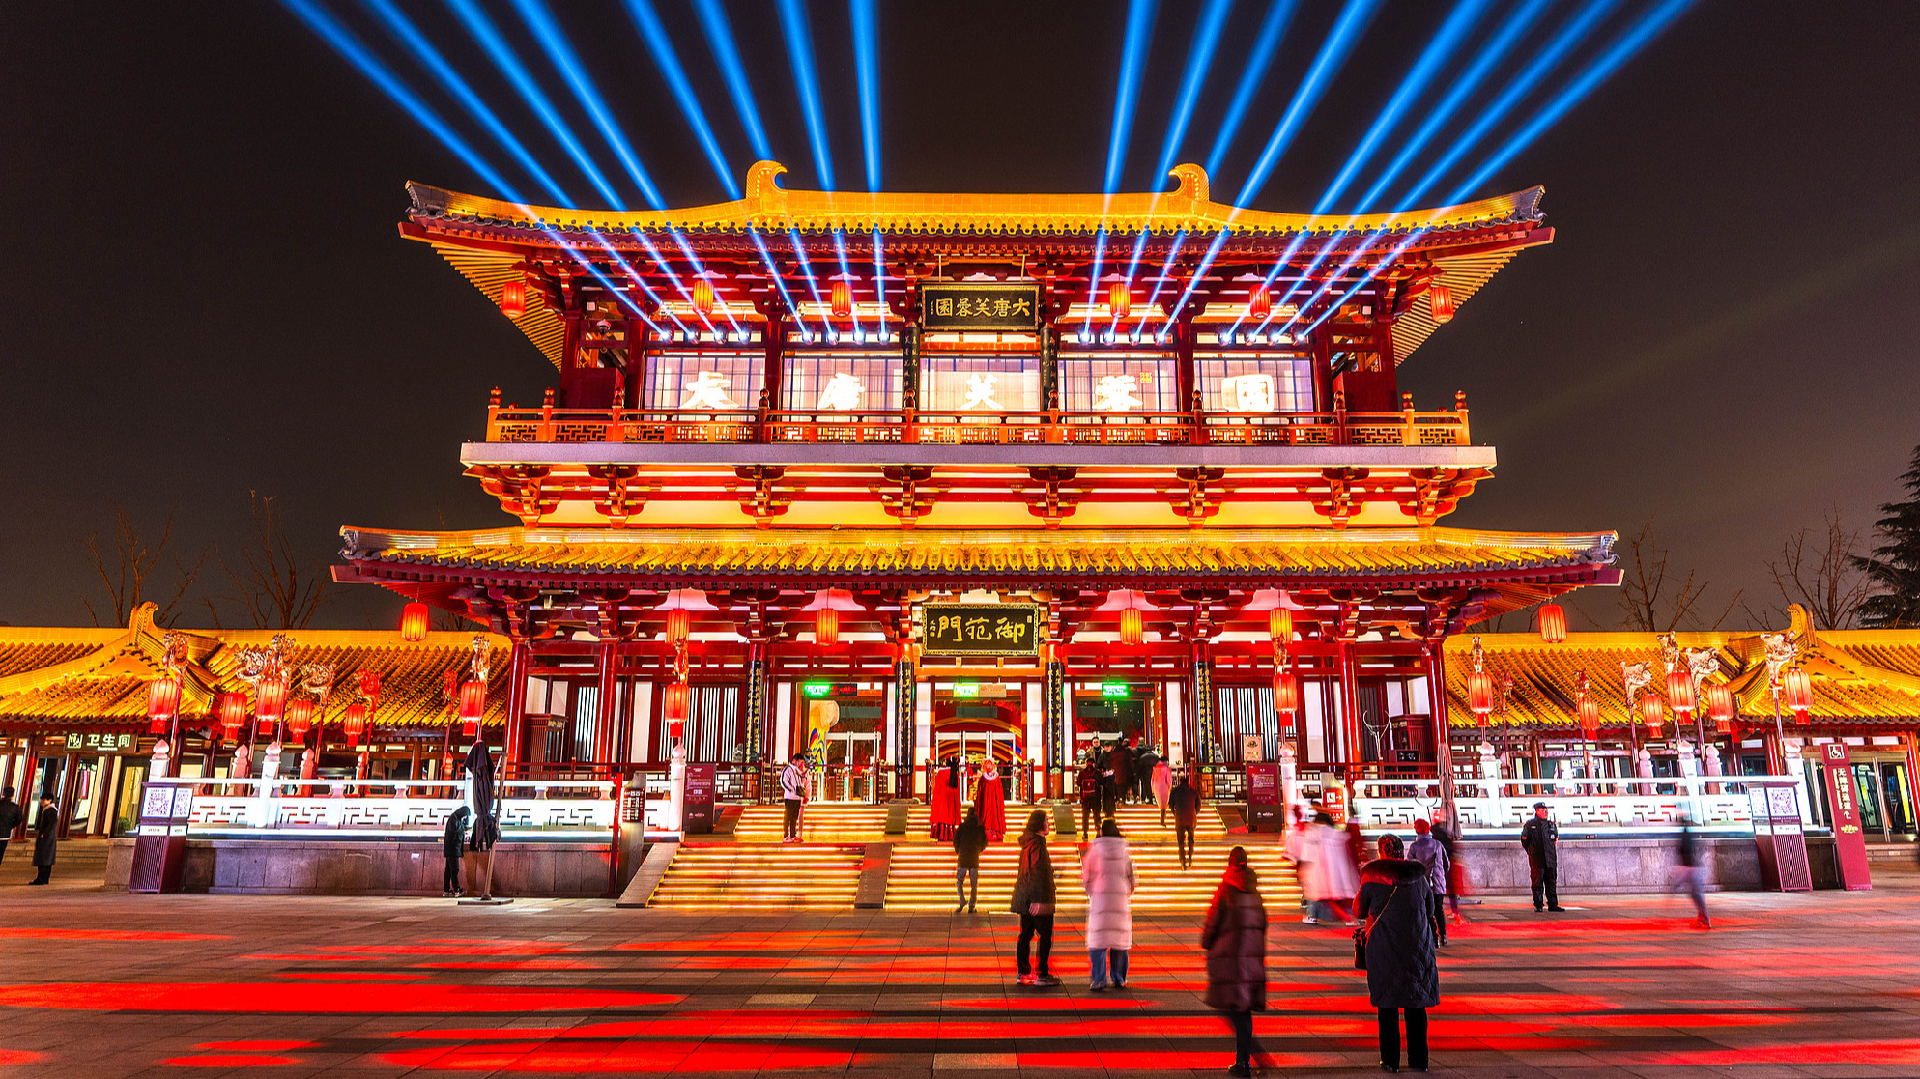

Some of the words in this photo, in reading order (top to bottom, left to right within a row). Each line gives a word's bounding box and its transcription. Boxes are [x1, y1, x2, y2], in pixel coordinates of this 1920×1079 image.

[936, 297, 1031, 317] 大唐芙蓉園
[86, 733, 131, 748] 卫生间
